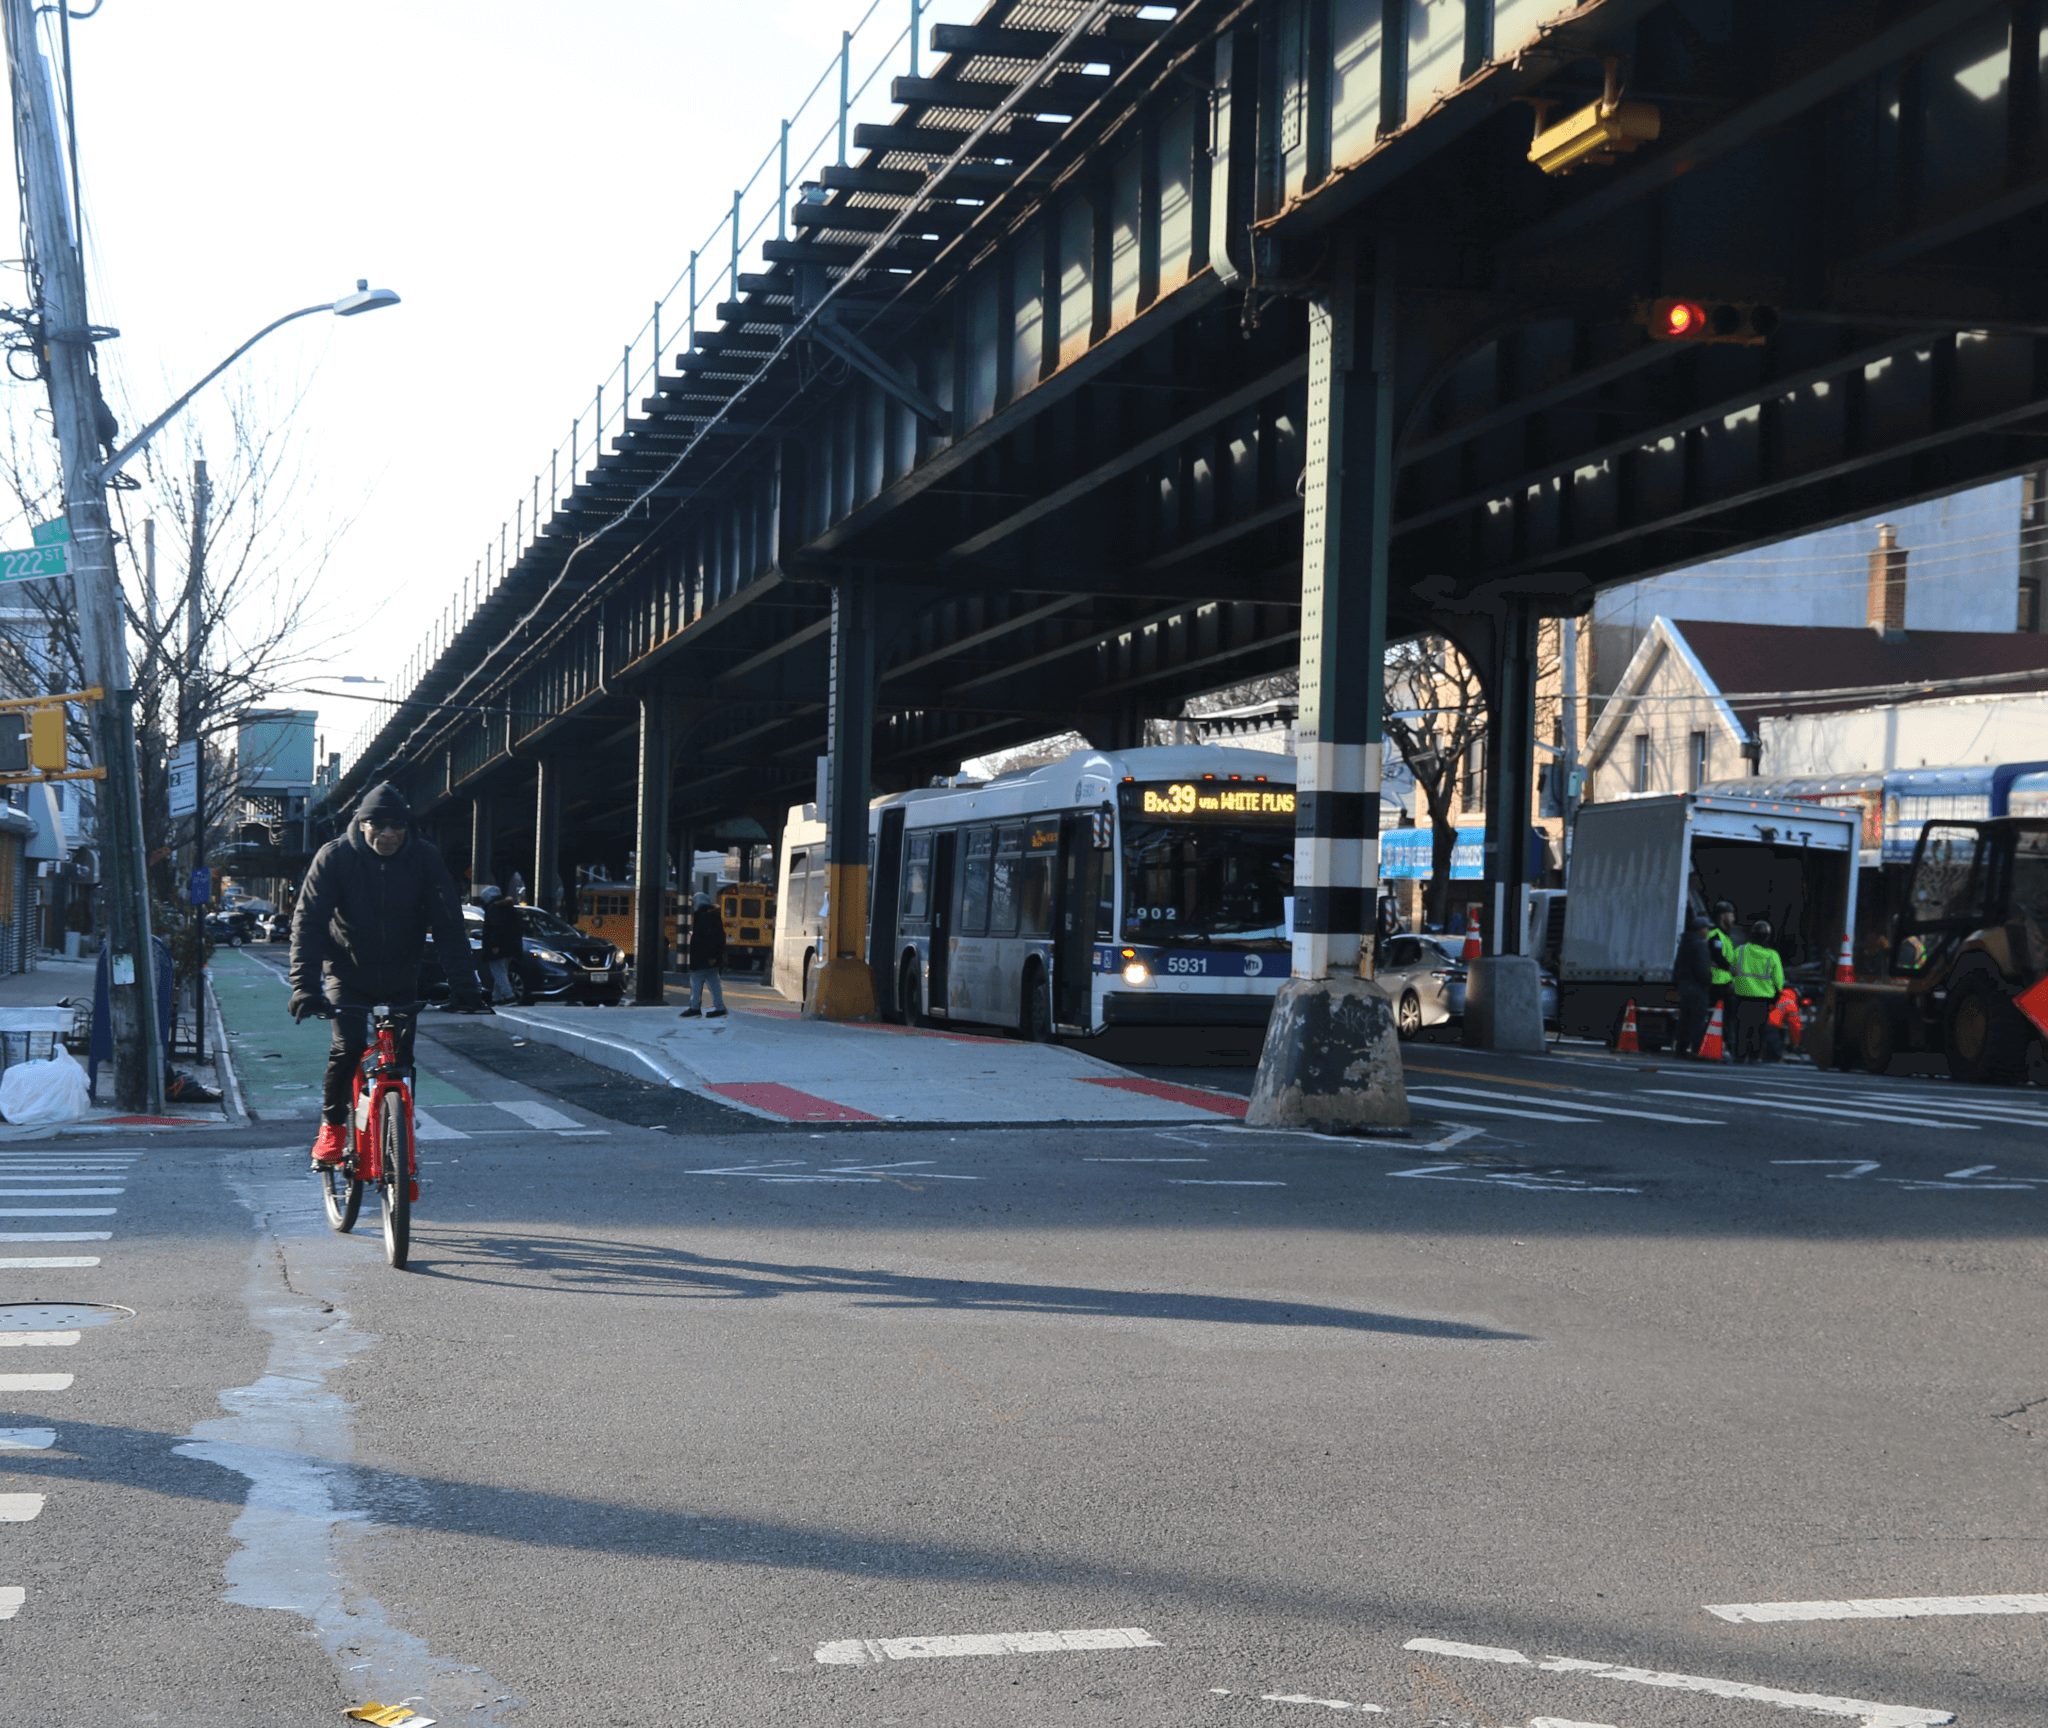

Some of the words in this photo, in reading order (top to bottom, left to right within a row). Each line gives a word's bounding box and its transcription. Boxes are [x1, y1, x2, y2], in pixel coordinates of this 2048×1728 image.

[3, 551, 44, 578] 222
[45, 548, 60, 561] ST
[1144, 784, 1196, 813] Bx39
[1220, 791, 1260, 811] WHITE
[1262, 792, 1295, 812] PLNS
[1168, 957, 1207, 973] 5931
